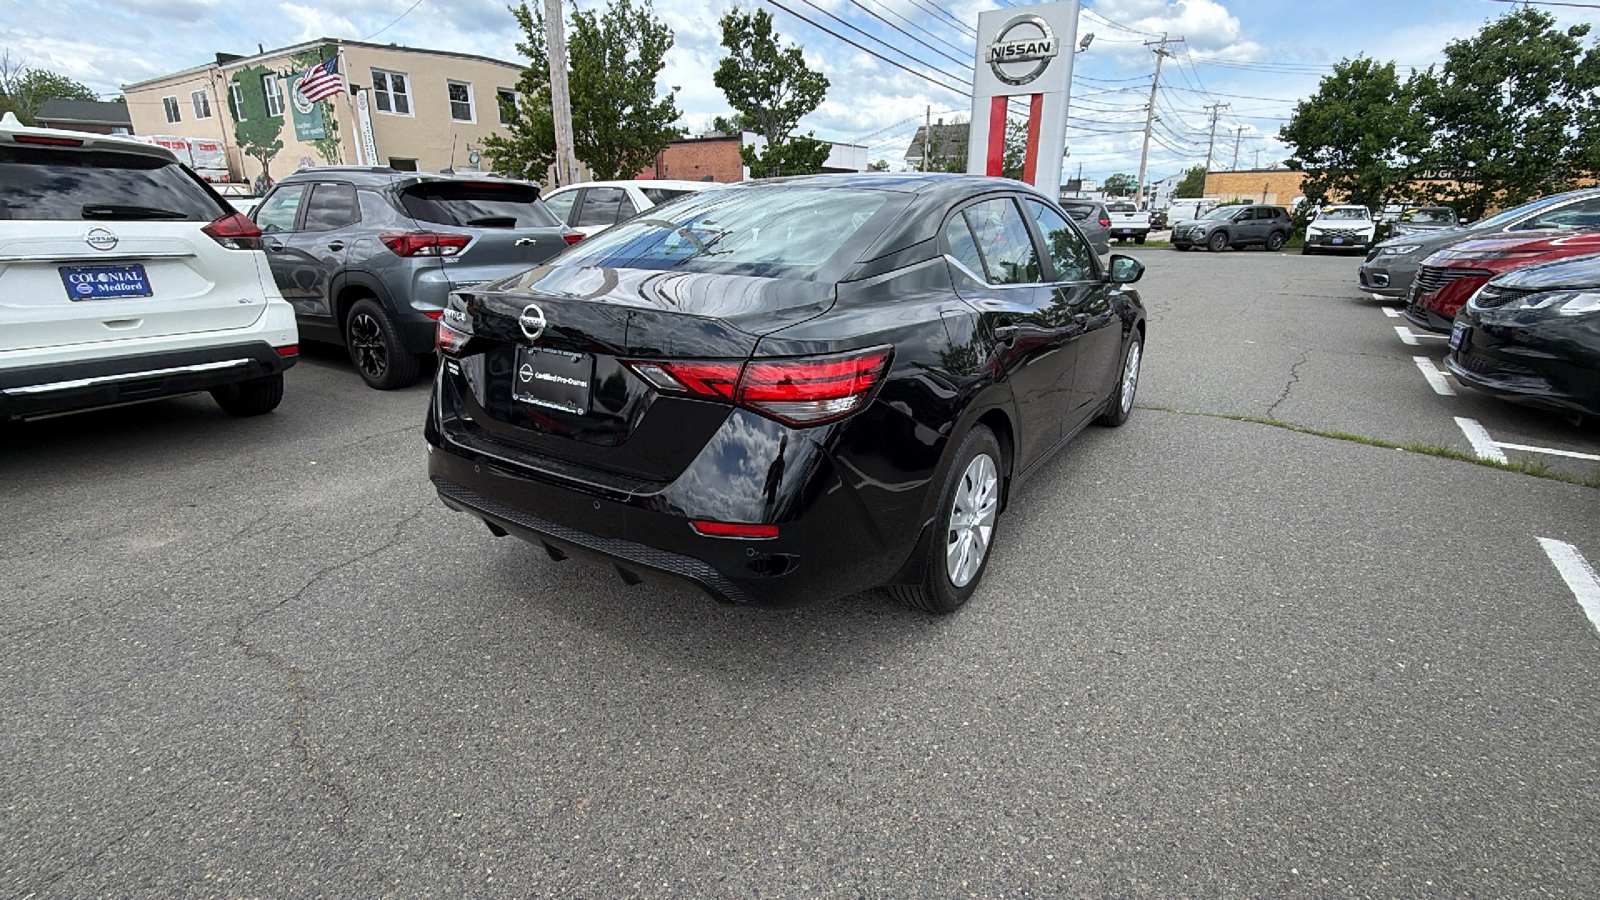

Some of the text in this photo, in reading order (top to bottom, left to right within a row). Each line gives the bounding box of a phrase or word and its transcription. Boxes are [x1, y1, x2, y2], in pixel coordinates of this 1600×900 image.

[991, 41, 1051, 58] NISSAN
[69, 271, 142, 284] COLONIAL
[98, 282, 143, 293] Medford
